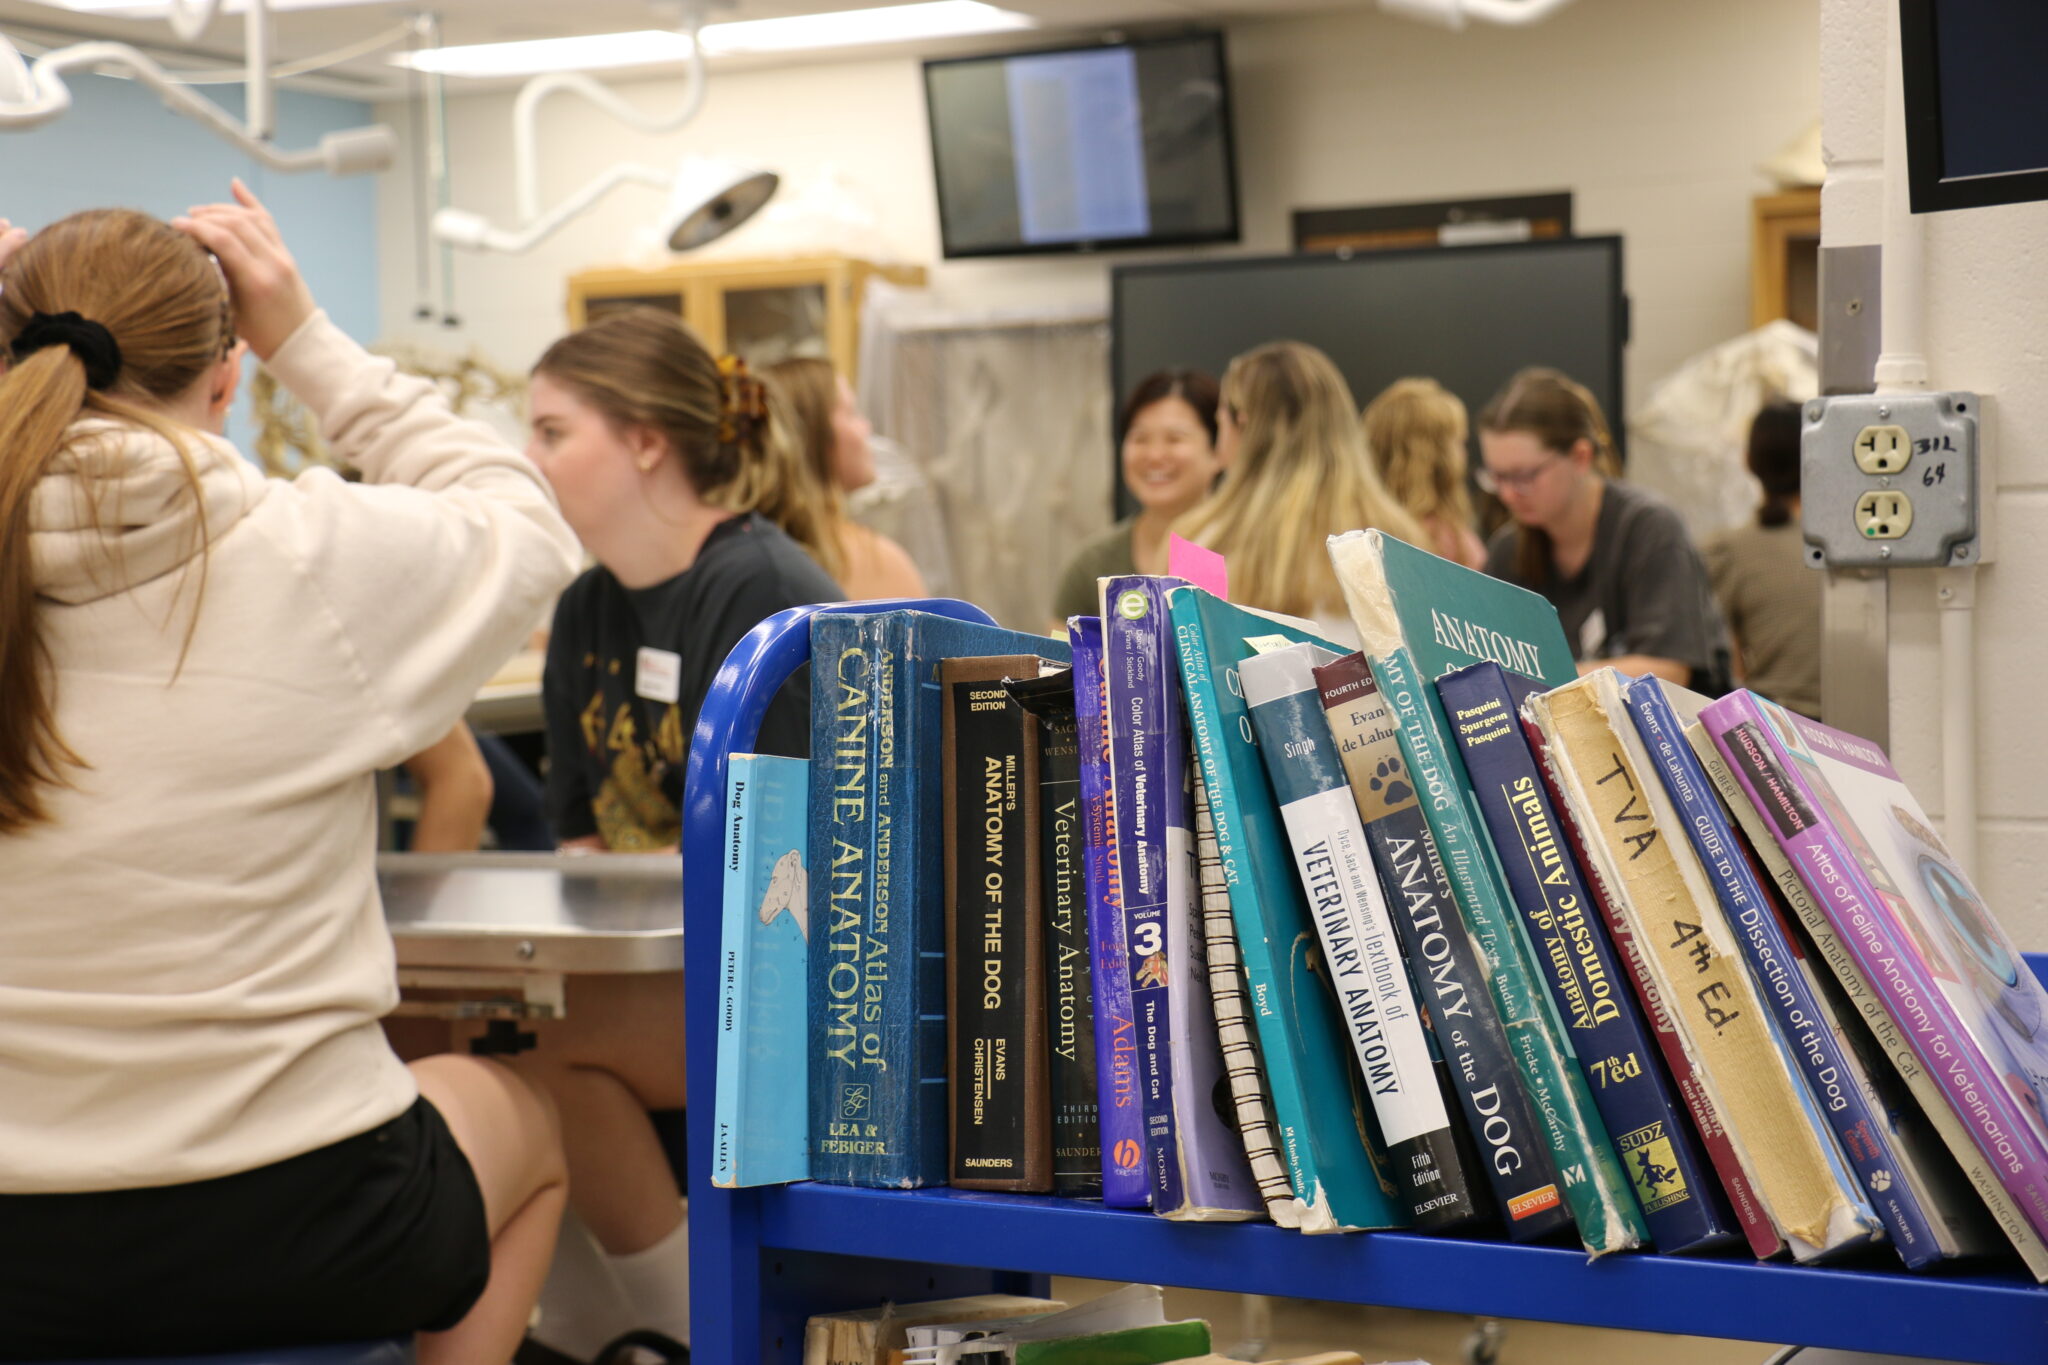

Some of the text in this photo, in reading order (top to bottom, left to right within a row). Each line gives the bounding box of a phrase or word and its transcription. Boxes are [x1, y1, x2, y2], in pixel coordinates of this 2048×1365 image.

[1922, 462, 1945, 487] 64
[1432, 608, 1546, 680] ANATOMY
[1137, 656, 1145, 681] Goody
[970, 689, 1007, 700] SECOND
[971, 701, 1006, 712] EDITION
[1324, 681, 1360, 700] FOURTH
[1456, 698, 1502, 721] Pasquini
[1459, 712, 1508, 735] Spurgeon
[1466, 724, 1511, 747] Pasquini
[1177, 625, 1239, 887] CLINICAL ANATOMY OF THE DOG & CAT
[1284, 737, 1316, 758] Singh
[1342, 738, 1357, 753] de
[1640, 701, 1694, 803] Evans de Lahunta
[1005, 754, 1016, 811] MILLER'S
[1131, 697, 1149, 895] Color Atlas of Veterinary Anatomy
[1708, 760, 1738, 798] GILBERT
[1735, 728, 1805, 831] HUDSON HAMILTON
[729, 781, 745, 872] Dog Anatomy
[1397, 691, 1417, 716] OF
[1407, 720, 1432, 764] THE
[1423, 767, 1450, 812] DOG
[1441, 822, 1457, 843] An
[1451, 849, 1491, 926] Illustrated
[1596, 752, 1657, 861] TVA
[1512, 776, 1570, 886] Animals
[826, 647, 870, 1070] CANINE ANATOMY
[862, 649, 895, 1073] ANDERSON and ANDERSON Atlas of
[1345, 853, 1357, 873] Sack
[983, 756, 1003, 1010] ANATOMY OF THE DOG
[1351, 874, 1363, 890] and
[1052, 798, 1081, 1061] Veterinary Anatomy
[1134, 910, 1161, 920] VOLUME
[1356, 890, 1376, 931] Wensing's
[1134, 922, 1162, 956] 3
[1556, 893, 1621, 1026] Domestic
[727, 951, 735, 983] PETER
[1302, 840, 1399, 1096] VETERINARY ANATOMY
[1364, 931, 1403, 1002] Textbook
[1529, 909, 1593, 1029] Anatomy of
[1695, 815, 1848, 1111] GUIDE TO THE Dissection of the Dog
[1778, 868, 1920, 1080] Pictorial Anatomy of the Cat
[725, 997, 733, 1032] GOODY
[1255, 983, 1273, 1017] Boyd
[1385, 836, 1522, 1176] ANATOMY of the DOG
[1385, 1005, 1409, 1022] of
[1806, 844, 2024, 1174] Atlas of Feline Anatomy for Veterinarians
[995, 1038, 1006, 1080] EVANS
[1112, 1015, 1136, 1108] Adams
[1146, 1000, 1160, 1100] The Dog and Cat
[1496, 973, 1567, 1152] Budras Fricke McCarthy
[974, 1038, 984, 1125] CHRISTENSEN
[829, 1123, 878, 1137] LEA &
[1063, 1105, 1098, 1113] THIRD
[1149, 1114, 1169, 1125] SECOND
[1681, 1079, 1715, 1139] and HABEL
[821, 1141, 886, 1154] FEBIGER
[1151, 1126, 1169, 1136] EDITION
[1619, 1123, 1665, 1151] SUDZ
[965, 1158, 1013, 1168] SAUNDERS
[1157, 1147, 1168, 1192] MOSBY
[1411, 1152, 1431, 1169] Fifth
[1412, 1168, 1441, 1187] Edition
[1414, 1193, 1459, 1216] ELSEVIER
[1511, 1192, 1557, 1215] ELSEVIER
[1732, 1177, 1757, 1225] SAUNDERS
[1888, 1199, 1916, 1245] SAUNDERS
[1971, 1166, 2028, 1244] WASHINGTON
